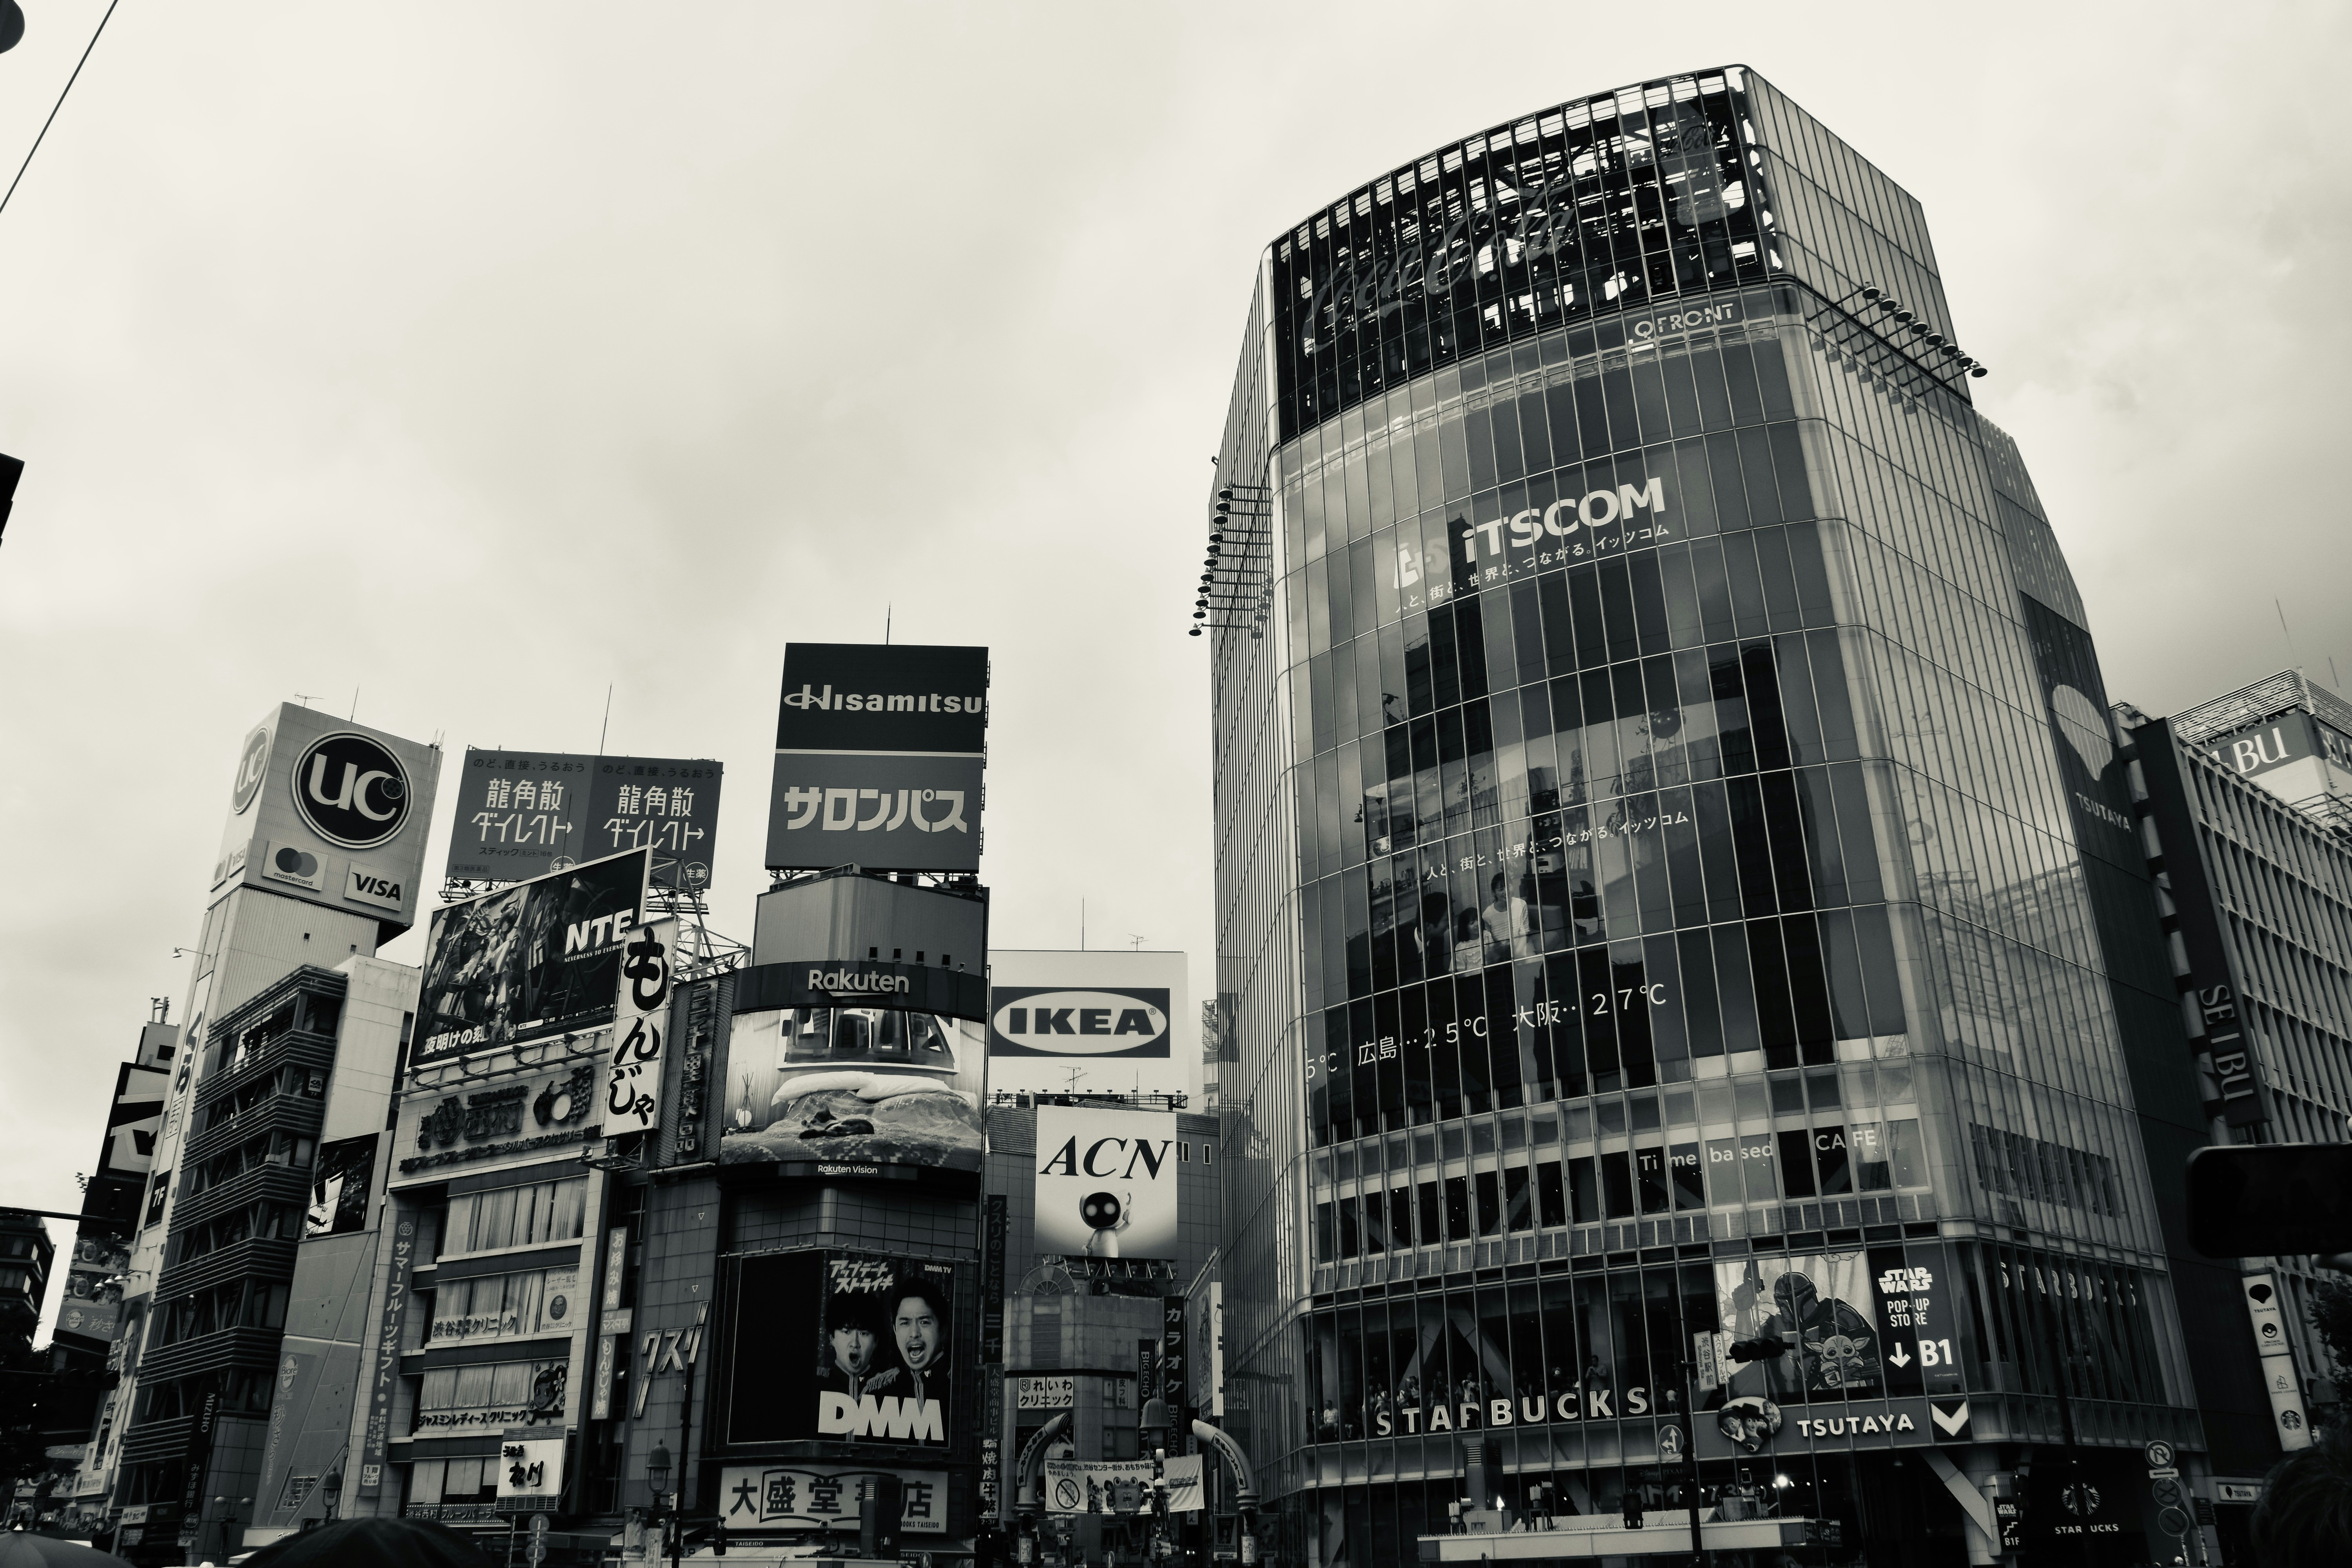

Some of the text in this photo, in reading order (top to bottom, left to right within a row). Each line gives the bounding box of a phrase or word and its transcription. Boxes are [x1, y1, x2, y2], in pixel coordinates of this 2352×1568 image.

[1634, 303, 1733, 338] QFRONT
[784, 685, 982, 713] Hisamitsu
[473, 758, 585, 773] のど、直接、うるおう
[603, 764, 715, 779] のど、直接、うるおう
[486, 778, 564, 811] 龍角散
[617, 784, 694, 817] 龍角散
[784, 786, 967, 833] サロンパス
[2074, 791, 2132, 833] TSUTAYA
[471, 812, 573, 845] ダイレクト
[603, 818, 704, 851] ダイレクト
[479, 847, 519, 856] スティック
[273, 870, 314, 887] mastercard
[352, 871, 401, 901] VISA
[686, 868, 706, 878] 生薬
[565, 908, 633, 955] NTE
[564, 952, 593, 963] NEVERNESS
[603, 942, 626, 954] EVERNES
[808, 968, 909, 993] Rakuten
[609, 926, 669, 1126] もんじゃ
[1009, 1007, 1156, 1035] IKEA
[423, 1024, 490, 1055] 夜明けの刻
[2198, 984, 2254, 1103] SEIBU
[1039, 1135, 1174, 1180] ACN
[1710, 1140, 1775, 1163] based
[1815, 1129, 1877, 1151] CAFE
[818, 1164, 878, 1174] Rakuten Vision
[153, 1185, 167, 1208] 7F
[989, 1200, 1004, 1305] クスリのことなら
[606, 1232, 624, 1305] お好み焼
[829, 1260, 889, 1278] アップデート
[924, 1264, 942, 1273] DMM
[1878, 1267, 1933, 1294] STAR WARS
[834, 1274, 894, 1294] ストライキ
[379, 1241, 410, 1387] サマーフルーツギフト
[1887, 1298, 1930, 1314] POP-UP
[1141, 1351, 1150, 1369] BIG
[1166, 1308, 1182, 1394] カラオケ
[1701, 1336, 1714, 1385] 渋谷駅前
[1715, 1336, 1727, 1382] スクランブル式
[1919, 1338, 1953, 1367] B1
[281, 1363, 298, 1376] Bioré
[1141, 1370, 1150, 1398] ECHO
[1020, 1394, 1073, 1406] クリニック
[1033, 1379, 1073, 1393] れいわ
[1118, 1379, 1127, 1406] 皮フ科
[201, 1392, 216, 1433] MIZUHO
[817, 1390, 944, 1441] DMM
[989, 1369, 1002, 1436] 大盛堂商事ビル
[1796, 1413, 1915, 1438] TSUTAYA
[1168, 1428, 1178, 1457] ECHO
[184, 1463, 200, 1508] みずほ銀行
[730, 1476, 933, 1518] 大盛堂店
[2004, 1537, 2020, 1546] B1F
[2054, 1523, 2120, 1535] STARUCKS
